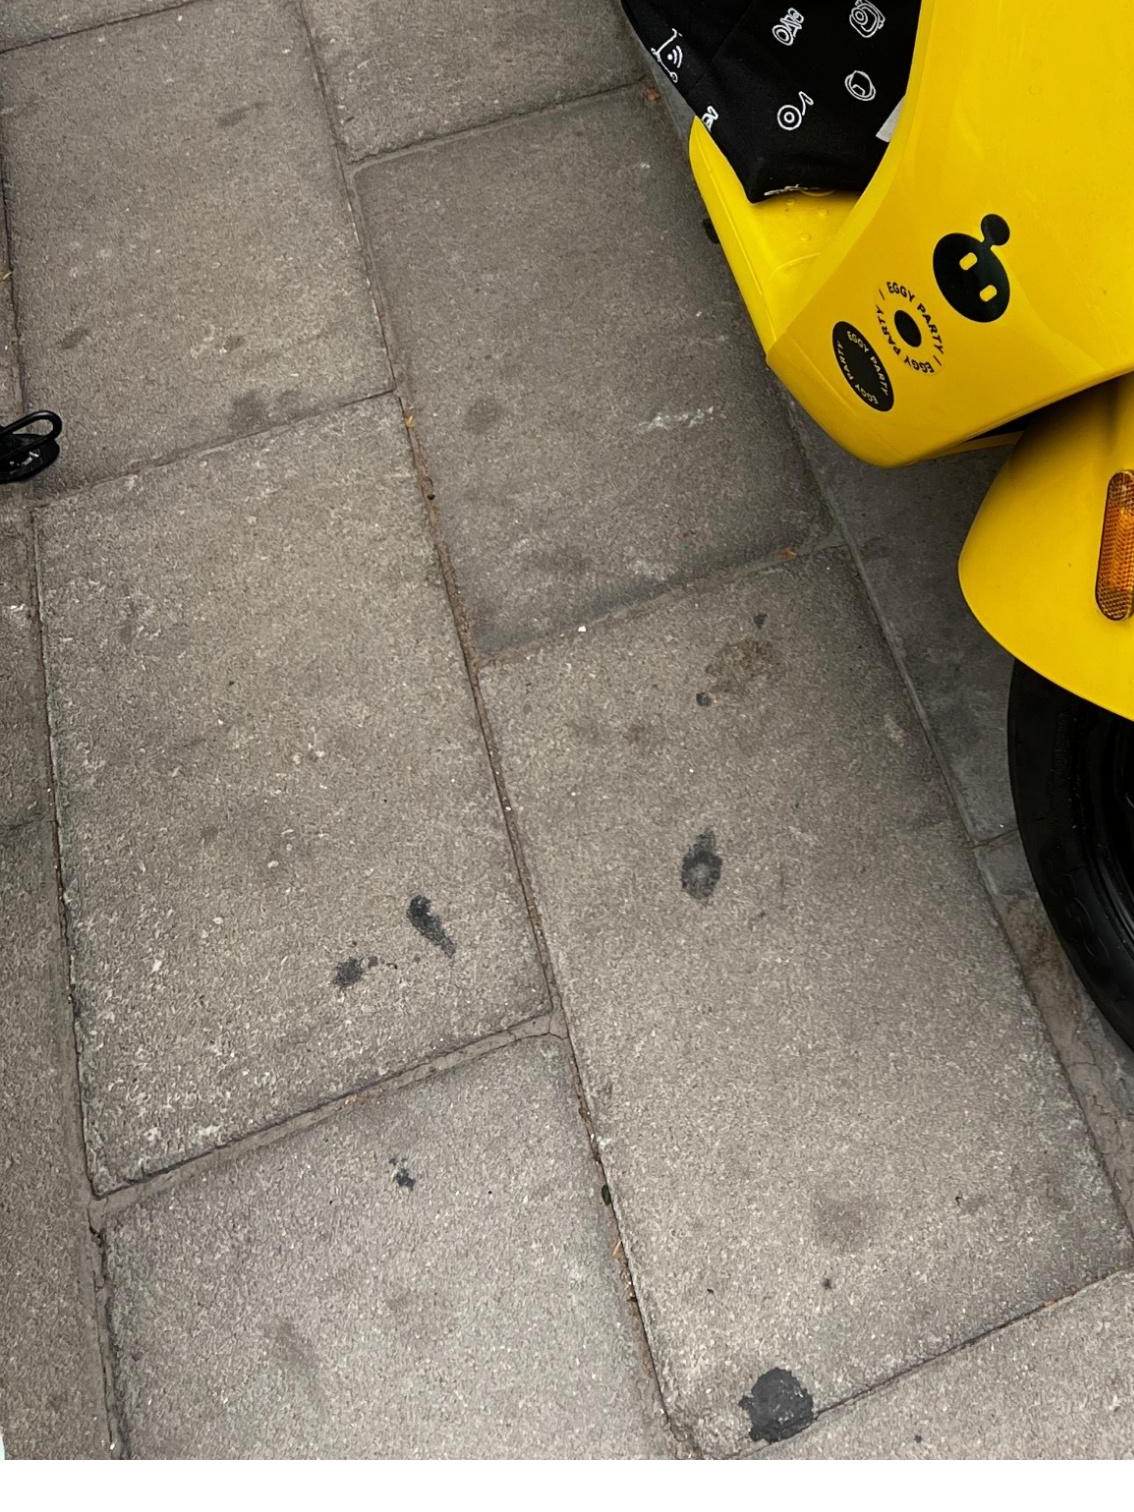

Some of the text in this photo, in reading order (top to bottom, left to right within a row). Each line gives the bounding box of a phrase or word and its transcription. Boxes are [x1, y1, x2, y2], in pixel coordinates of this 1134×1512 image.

[875, 304, 935, 374] EGGY PARTY
[886, 281, 944, 355] EGGY PARTY
